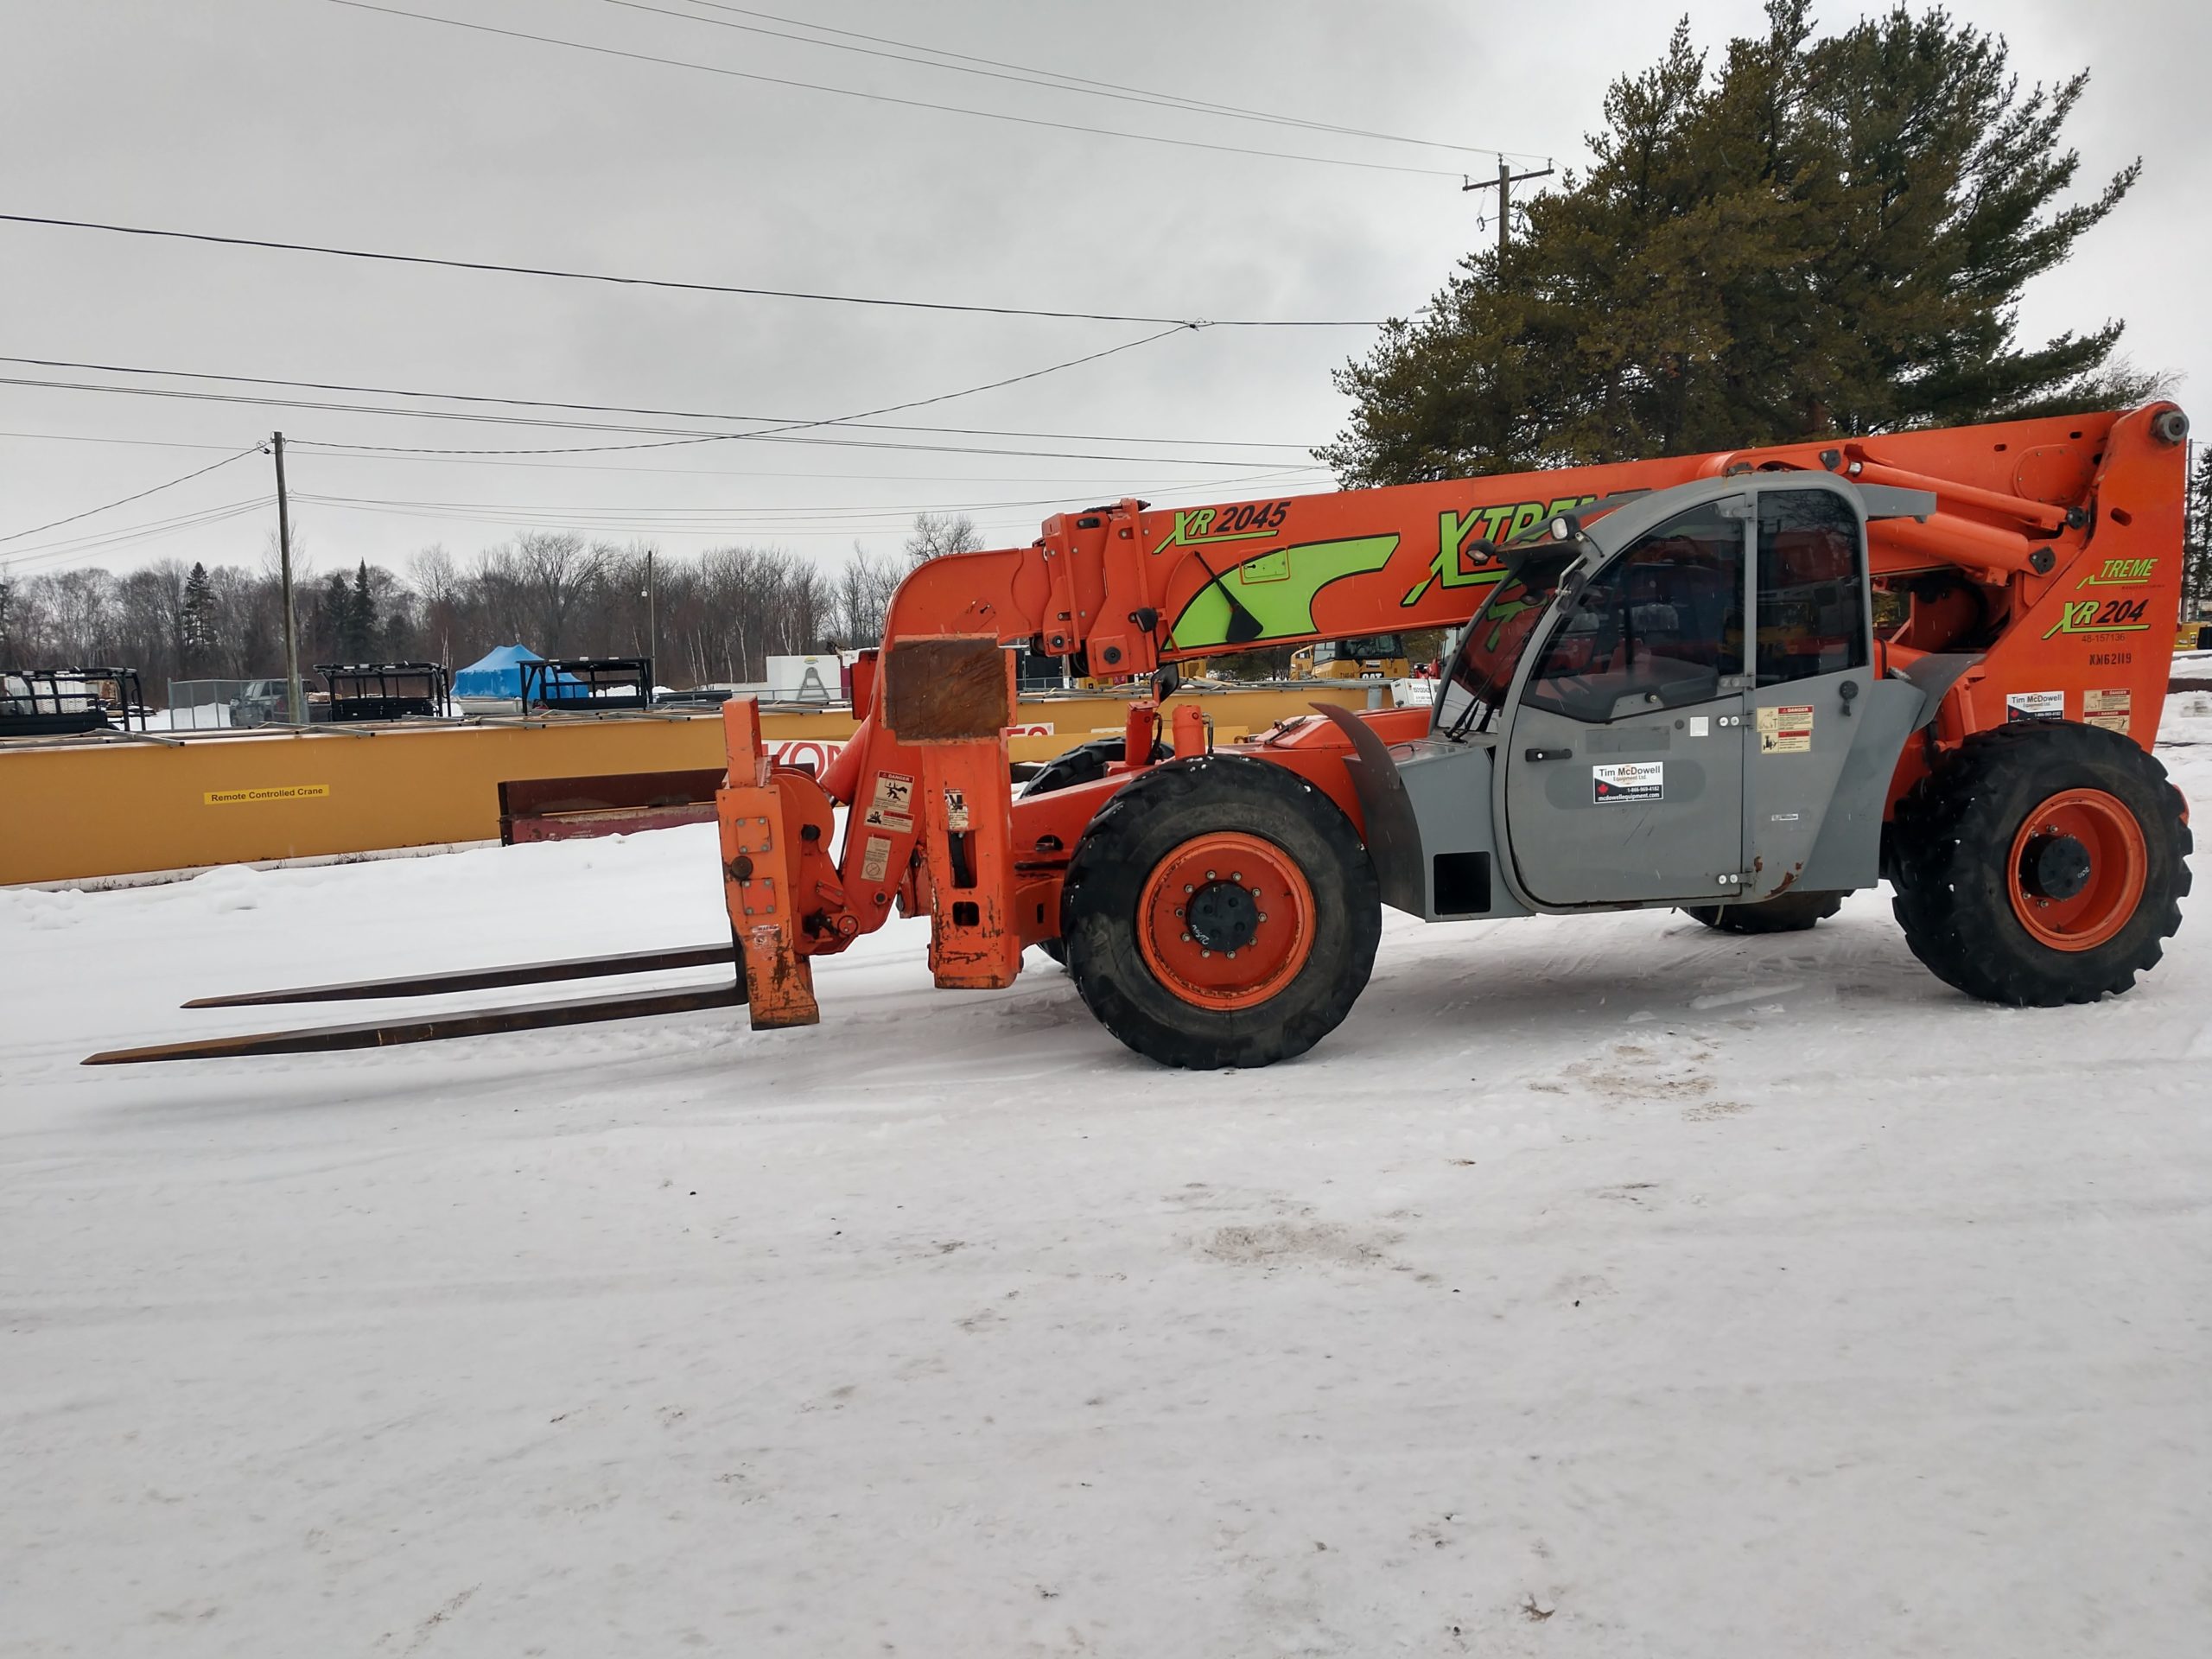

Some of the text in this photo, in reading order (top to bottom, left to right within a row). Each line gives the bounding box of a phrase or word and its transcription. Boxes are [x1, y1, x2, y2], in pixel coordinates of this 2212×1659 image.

[1215, 501, 1292, 533] 2045
[2082, 633, 2126, 643] 48-157136
[2027, 694, 2062, 702] McDowell
[1599, 766, 1661, 777] Tim McDowell
[249, 790, 295, 799] Controlled
[297, 787, 323, 796] Crane
